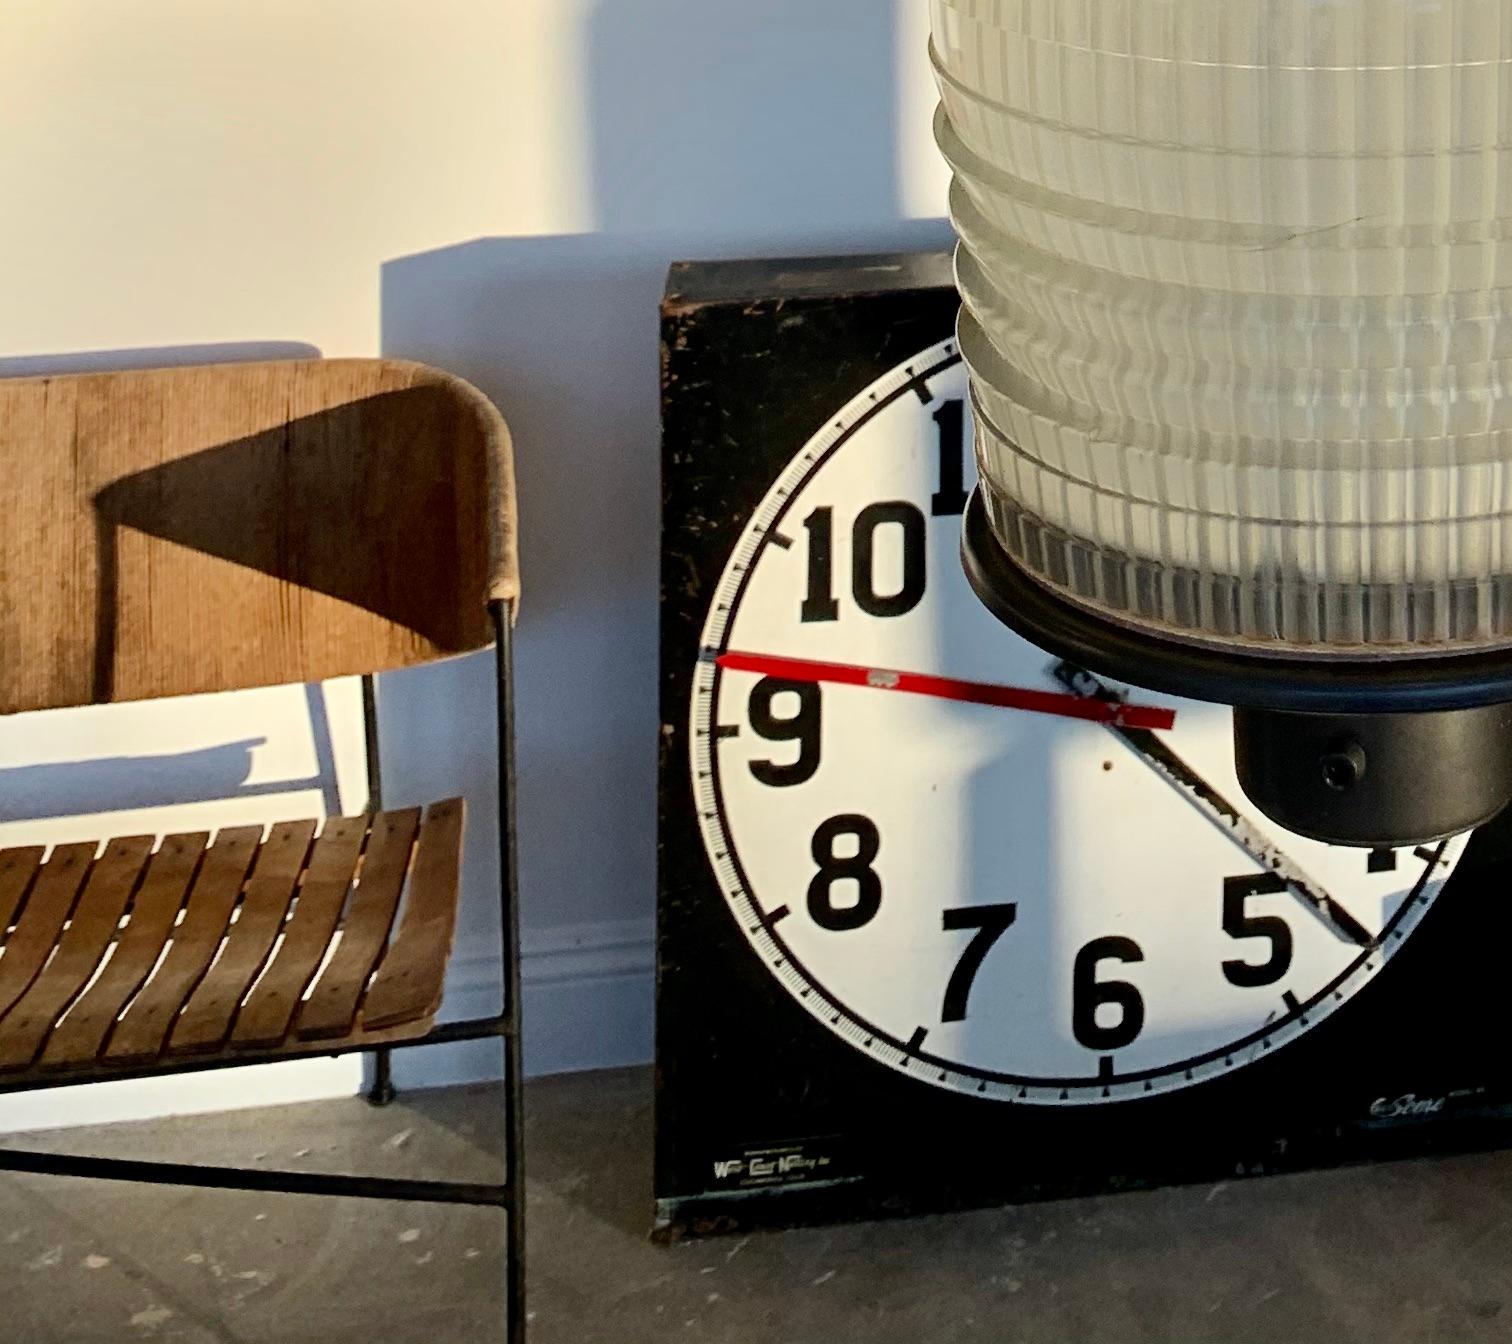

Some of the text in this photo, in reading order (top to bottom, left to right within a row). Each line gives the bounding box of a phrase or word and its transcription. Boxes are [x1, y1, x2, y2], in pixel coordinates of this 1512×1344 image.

[931, 398, 971, 517] 1
[799, 500, 929, 623] 10
[747, 675, 824, 787] 9
[805, 812, 883, 932] 8
[1219, 873, 1295, 988] 5
[941, 902, 1018, 1024] 7
[1072, 935, 1146, 1051] 6
